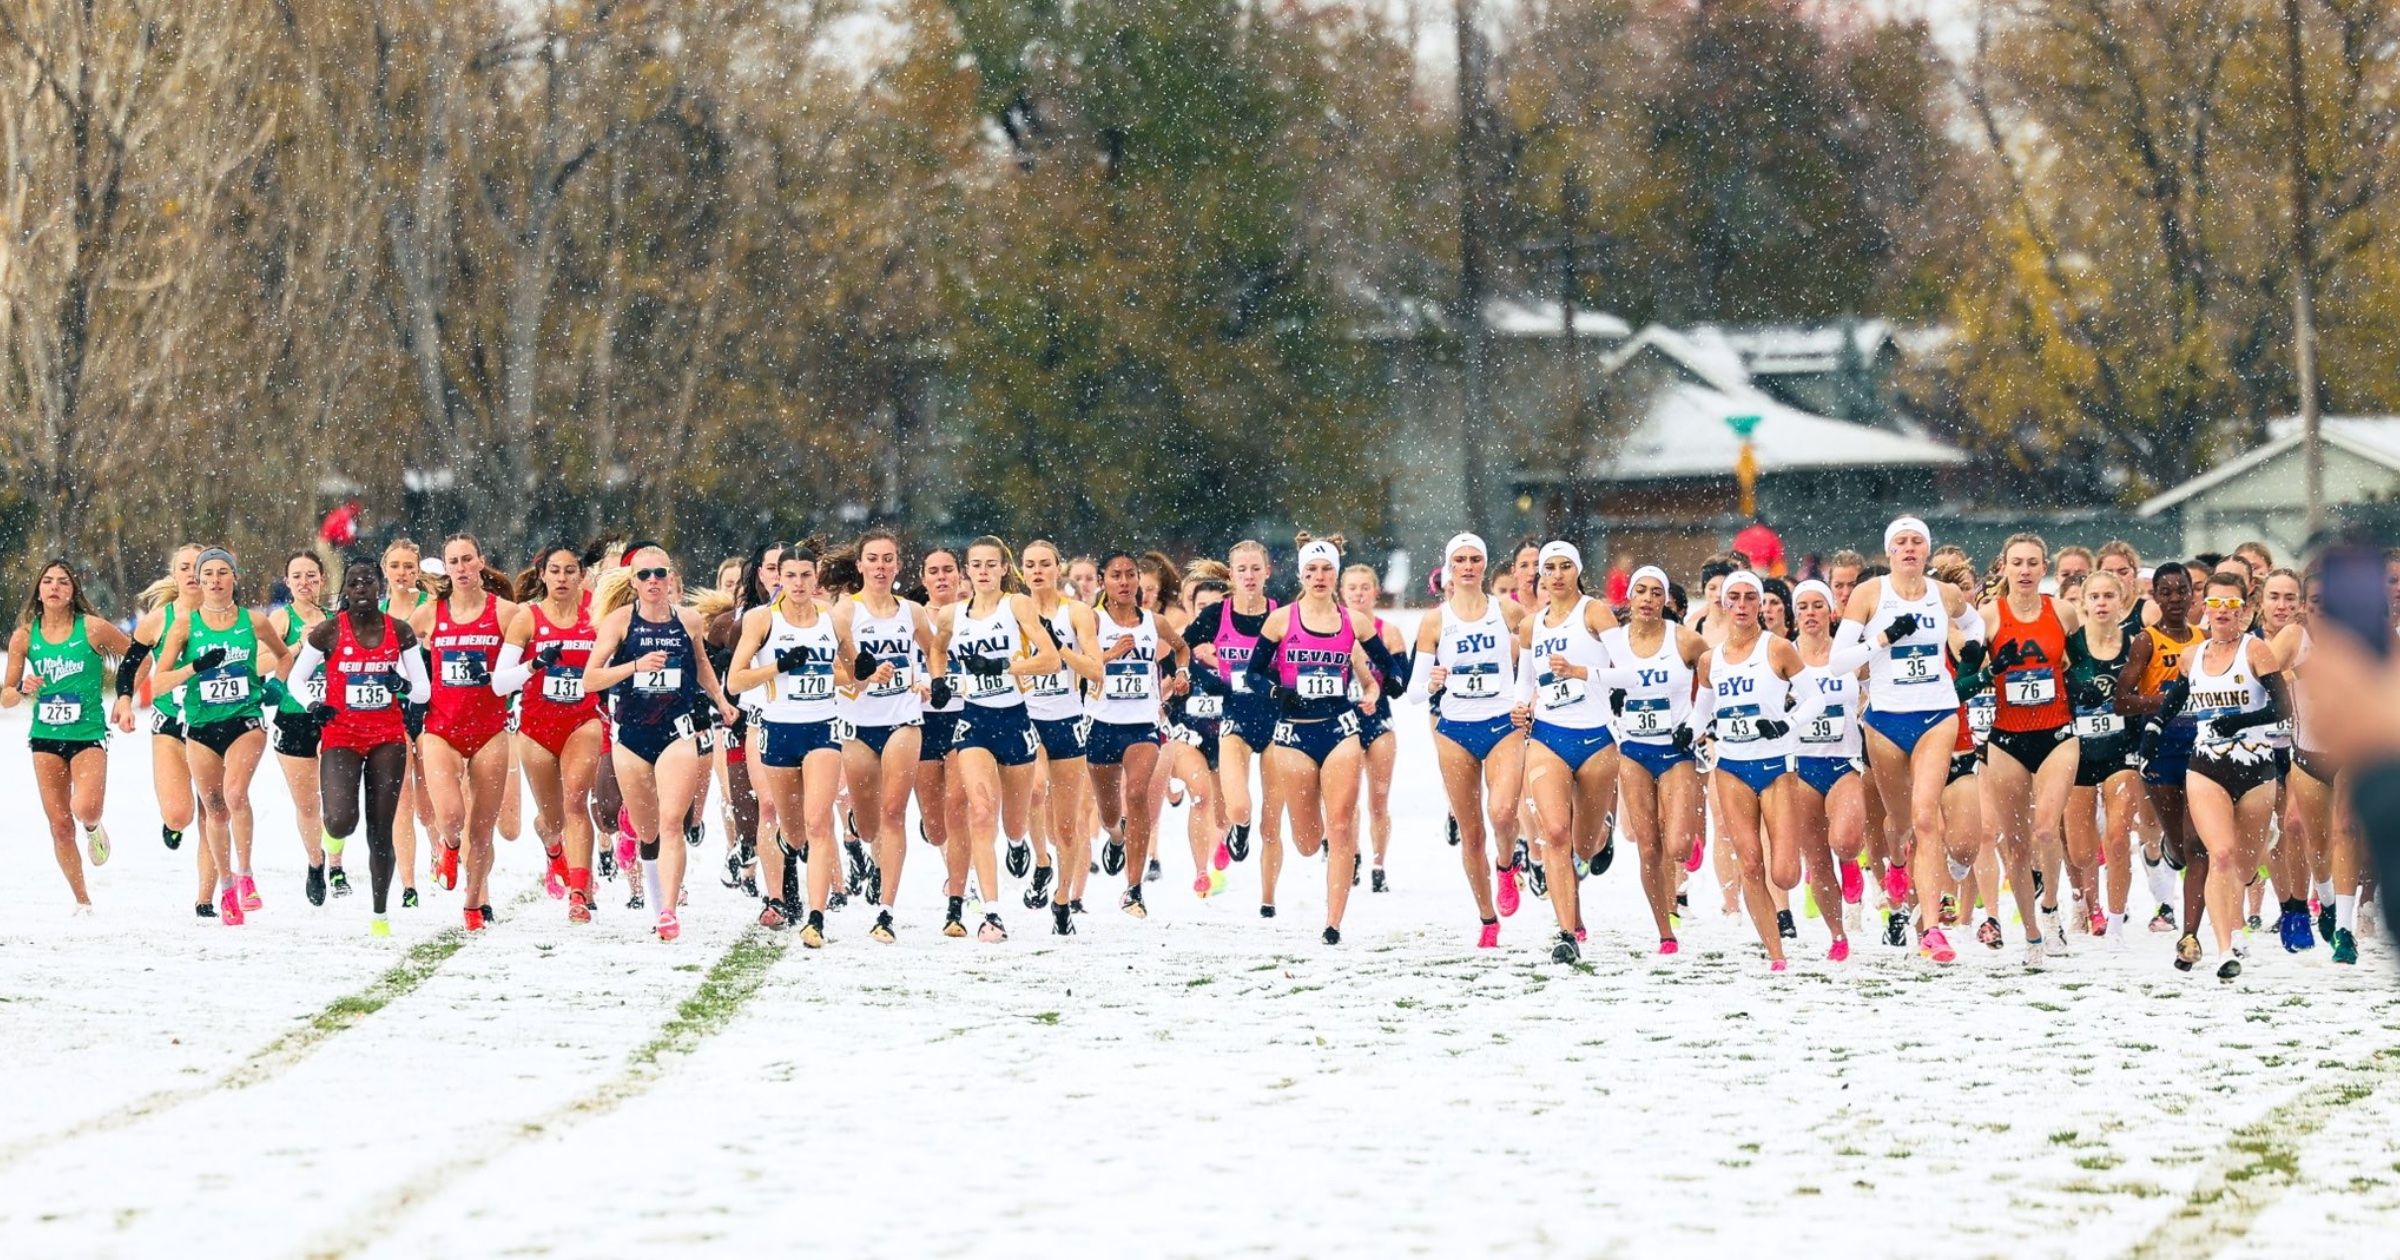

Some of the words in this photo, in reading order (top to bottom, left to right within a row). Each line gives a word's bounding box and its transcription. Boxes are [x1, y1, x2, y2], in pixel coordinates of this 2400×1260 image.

[434, 636, 456, 647] NEW
[457, 635, 499, 646] MEXICO
[640, 638, 653, 647] AIR
[656, 638, 682, 647] FORCE
[859, 639, 911, 654] NAU
[958, 635, 1009, 655] NAU
[1456, 633, 1496, 654] BYU
[1534, 637, 1568, 658] BYU
[338, 661, 363, 673] NEW
[451, 665, 472, 680] 13
[1907, 660, 1926, 676] 35
[649, 672, 667, 687] 21
[799, 677, 826, 694] 170
[976, 674, 1003, 691] 166
[1032, 674, 1059, 690] 174
[1116, 677, 1142, 693] 178
[1307, 679, 1334, 695] 113
[1467, 677, 1483, 692] 41
[1718, 676, 1754, 696] BYU
[210, 680, 239, 699] 279
[356, 687, 384, 704] 135
[553, 680, 578, 697] 131
[2020, 683, 2040, 699] 76
[47, 706, 72, 721] 275
[1198, 699, 1215, 713] 23
[1638, 713, 1657, 730] 36
[1977, 710, 1993, 726] 33
[2091, 717, 2110, 733] 59
[1731, 720, 1750, 735] 43
[1812, 721, 1831, 737] 39
